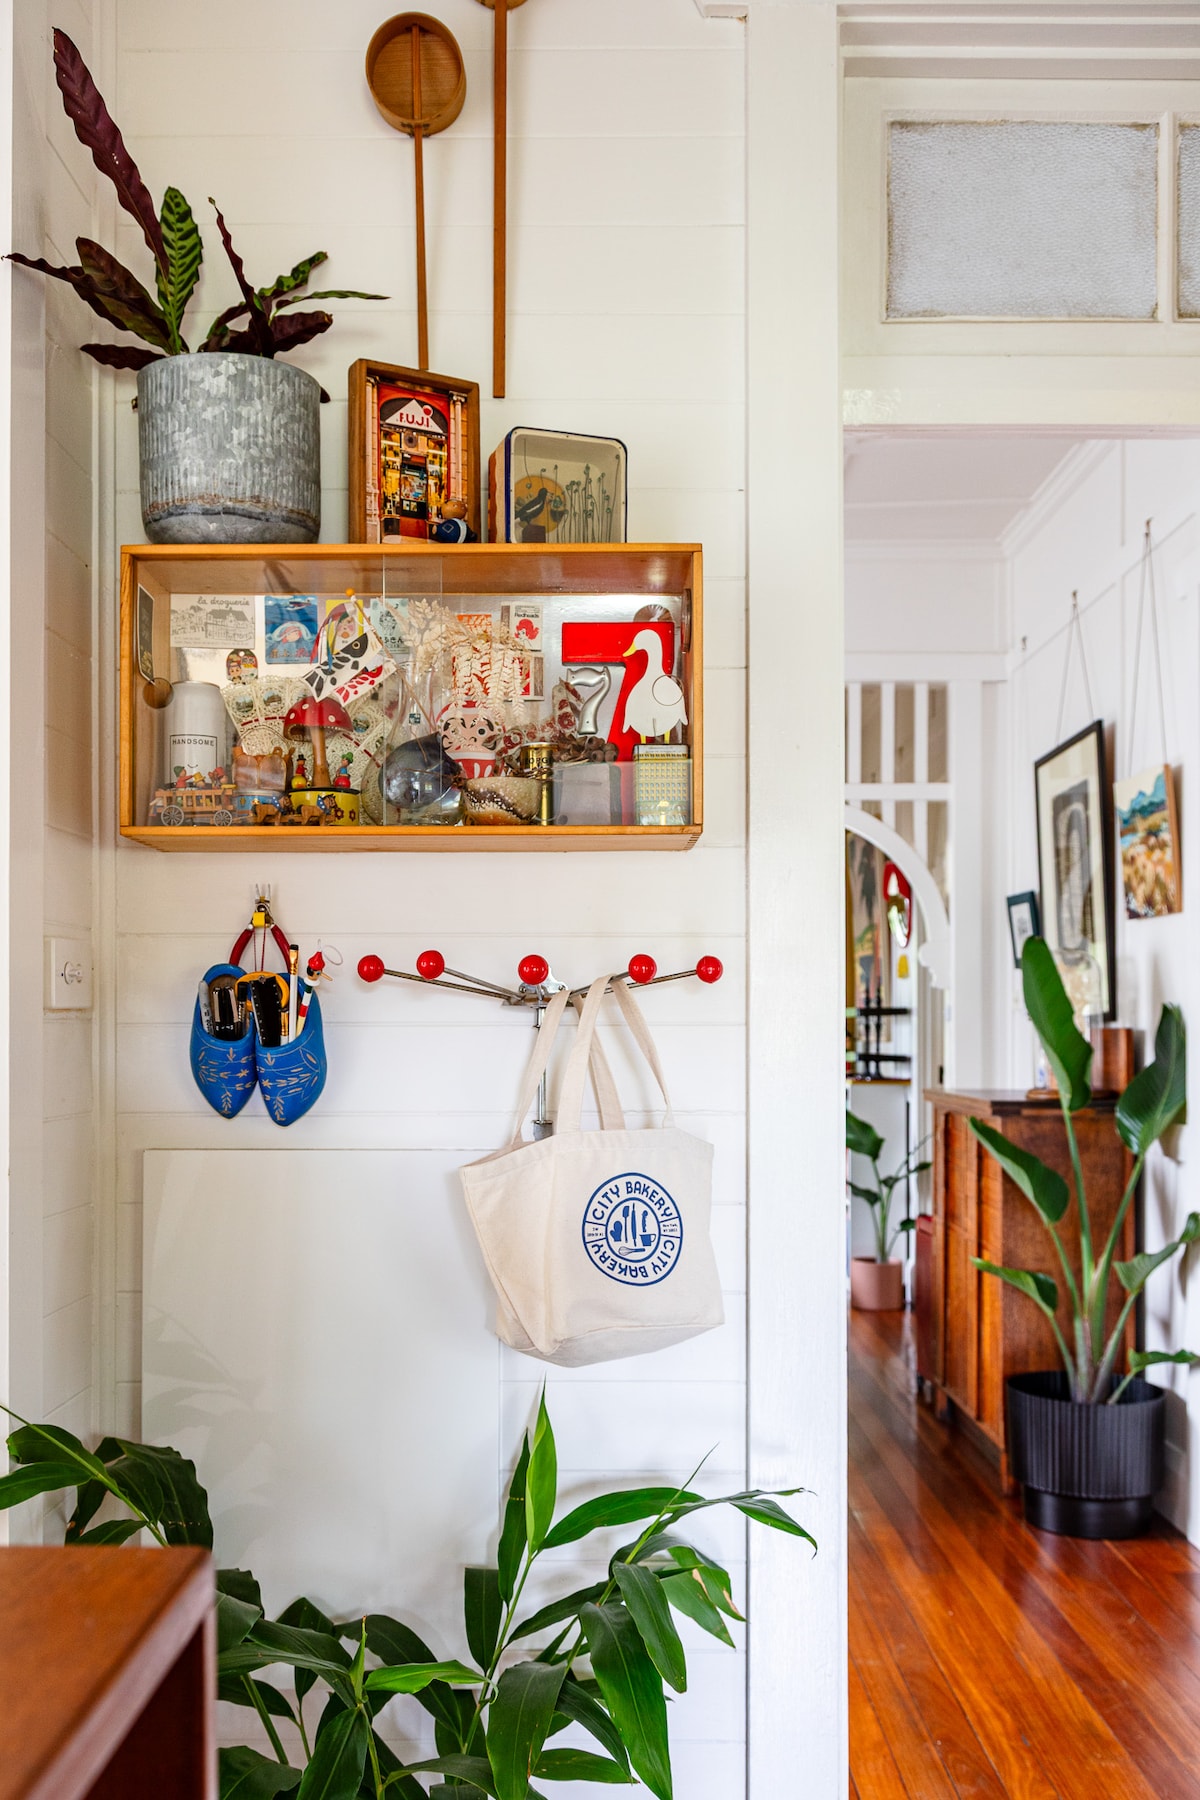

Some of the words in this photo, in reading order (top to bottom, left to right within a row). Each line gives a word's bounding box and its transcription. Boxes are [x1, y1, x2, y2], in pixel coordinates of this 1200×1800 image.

[400, 412, 429, 428] FUJI
[197, 596, 207, 605] la
[567, 666, 611, 735] 7
[172, 738, 215, 746] HANDSOME
[592, 1184, 620, 1220] CITY
[625, 1181, 673, 1217] BAKERY
[591, 1243, 649, 1278] BAKERY
[651, 1239, 675, 1275] CITY
